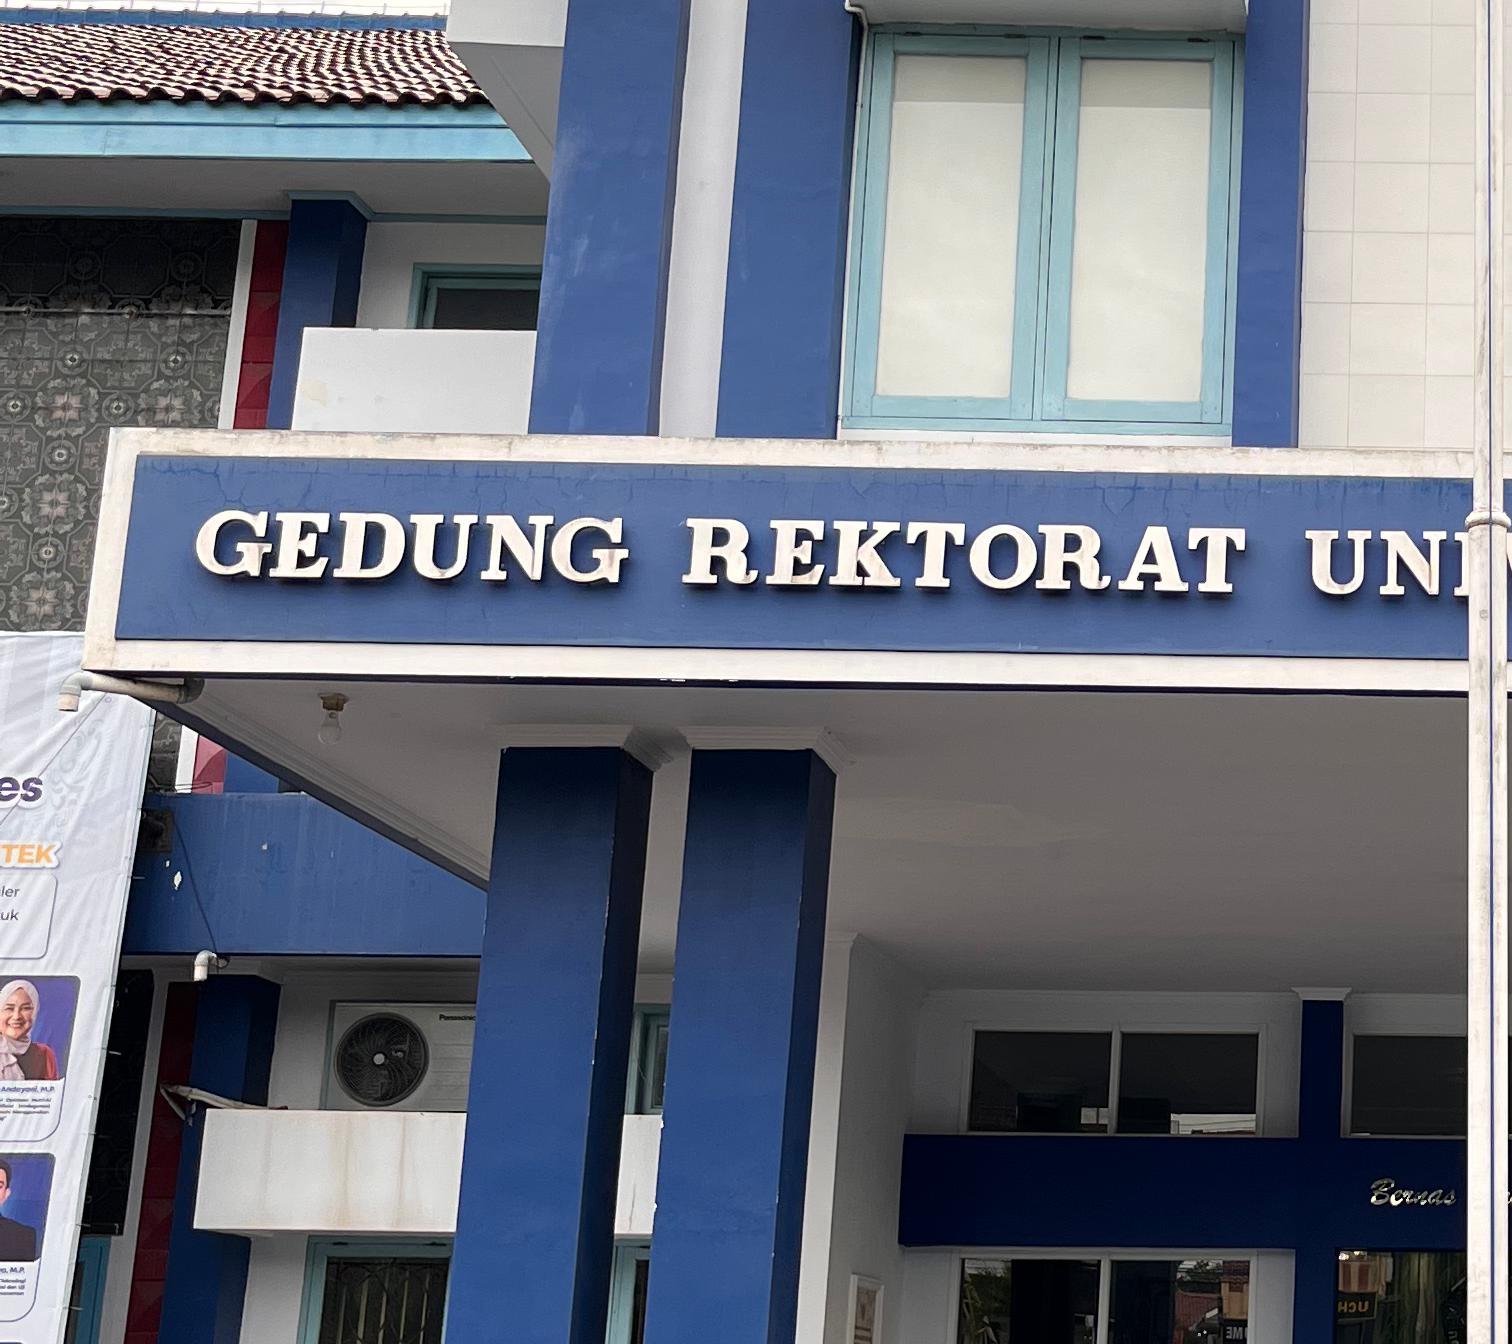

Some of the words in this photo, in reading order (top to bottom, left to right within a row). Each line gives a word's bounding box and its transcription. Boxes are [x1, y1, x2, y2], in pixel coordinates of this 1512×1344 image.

[195, 509, 630, 584] GEDUNG
[681, 517, 1247, 594] REKTORAT
[1370, 1177, 1457, 1207] Bernas
